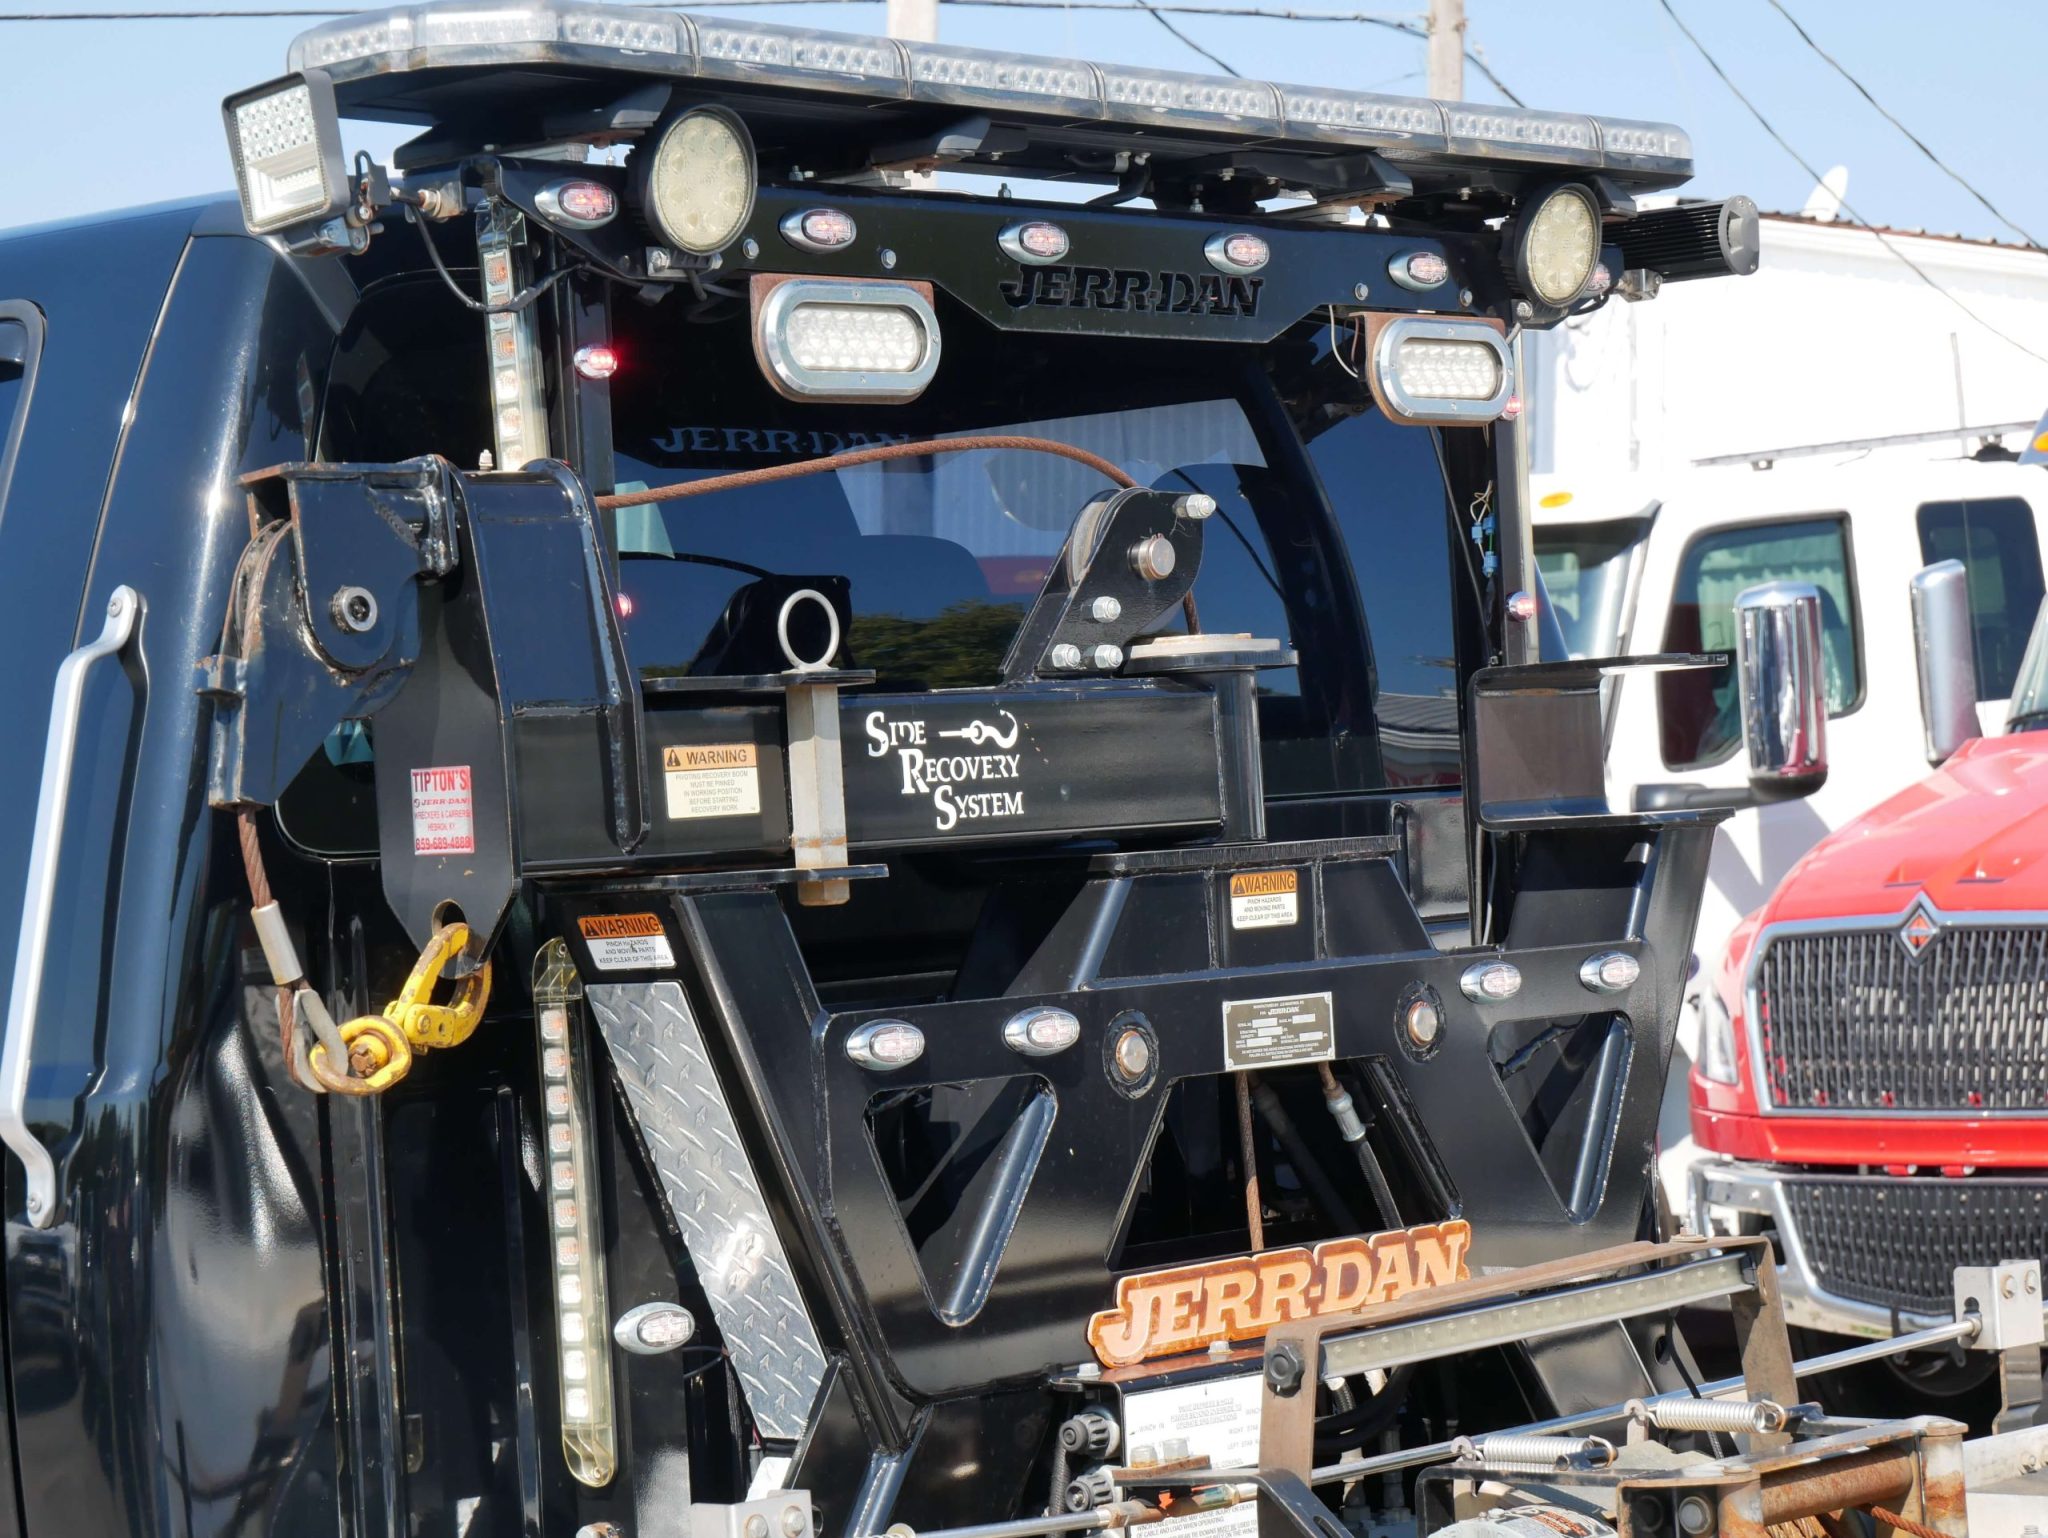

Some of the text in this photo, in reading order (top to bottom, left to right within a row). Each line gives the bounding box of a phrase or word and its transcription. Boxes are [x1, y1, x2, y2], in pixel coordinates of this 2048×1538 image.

[1000, 264, 1264, 318] JERR-DAN
[687, 749, 747, 765] WARNING
[675, 773, 701, 781] PIVOTING
[702, 771, 731, 779] RECOVERY
[898, 748, 1021, 794] RECOVERY
[412, 769, 469, 793] TIPTON'S
[690, 781, 705, 789] MUST
[715, 779, 735, 787] PINNED
[691, 788, 717, 797] WORKING
[717, 787, 743, 795] POSITION
[689, 797, 711, 805] BEFORE
[691, 805, 720, 813] RECOVERY
[934, 785, 1025, 830] SYSTEM
[1244, 873, 1295, 893] WARNING
[594, 916, 660, 935] WARNING
